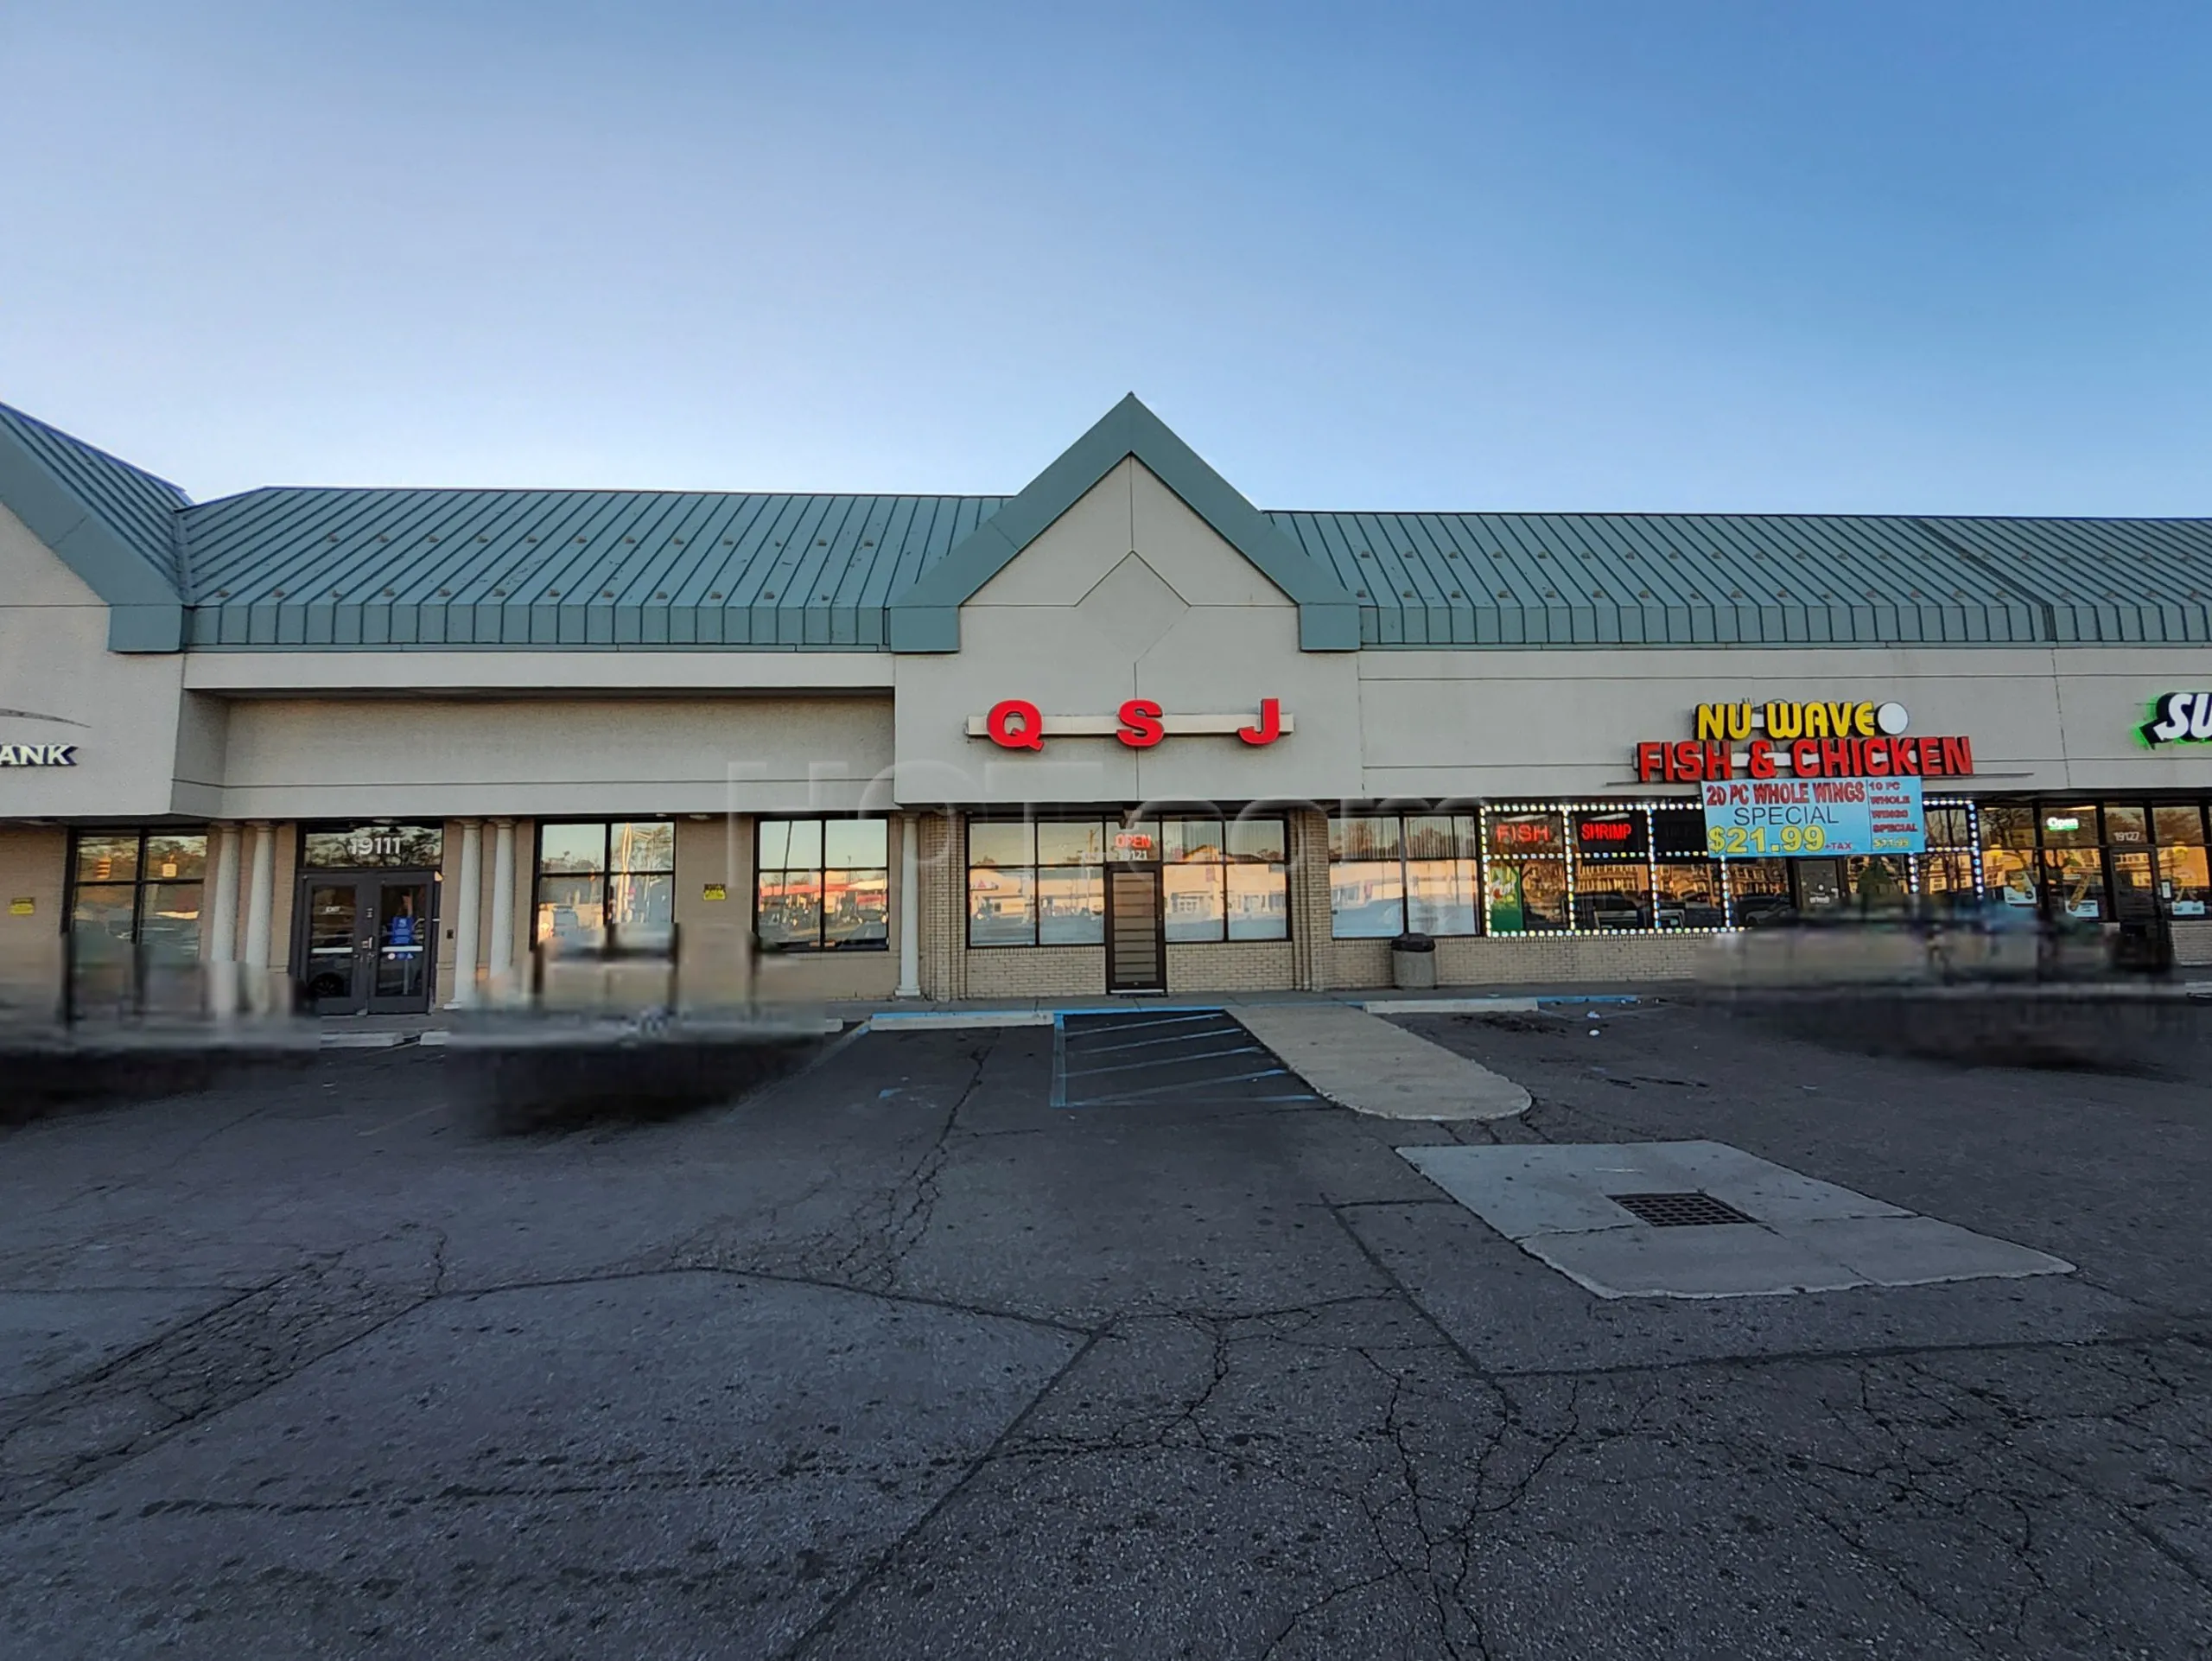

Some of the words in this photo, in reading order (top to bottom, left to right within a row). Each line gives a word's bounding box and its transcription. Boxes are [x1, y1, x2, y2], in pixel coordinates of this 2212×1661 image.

[987, 699, 1044, 751] Q
[1116, 699, 1164, 748] S
[1238, 698, 1281, 745] J
[1697, 703, 1751, 740] NU
[1766, 701, 1875, 738] WAVE
[1639, 740, 1733, 782] FISH
[1751, 741, 1777, 778] &
[1790, 736, 1973, 777] CHICKEN
[1707, 786, 1726, 805] 20
[1730, 784, 1750, 805] PC
[1753, 783, 1810, 804] WHOLE
[1813, 781, 1866, 803] WINGS
[1885, 781, 1900, 790] PC
[1734, 806, 1839, 825] SPECIAL
[1115, 833, 1151, 849] OPEN
[1496, 825, 1549, 842] FISH
[1581, 824, 1631, 840] SHRIMP
[1707, 825, 1825, 853] $21.99
[2113, 832, 2139, 841] 19127
[349, 837, 401, 854] 19111
